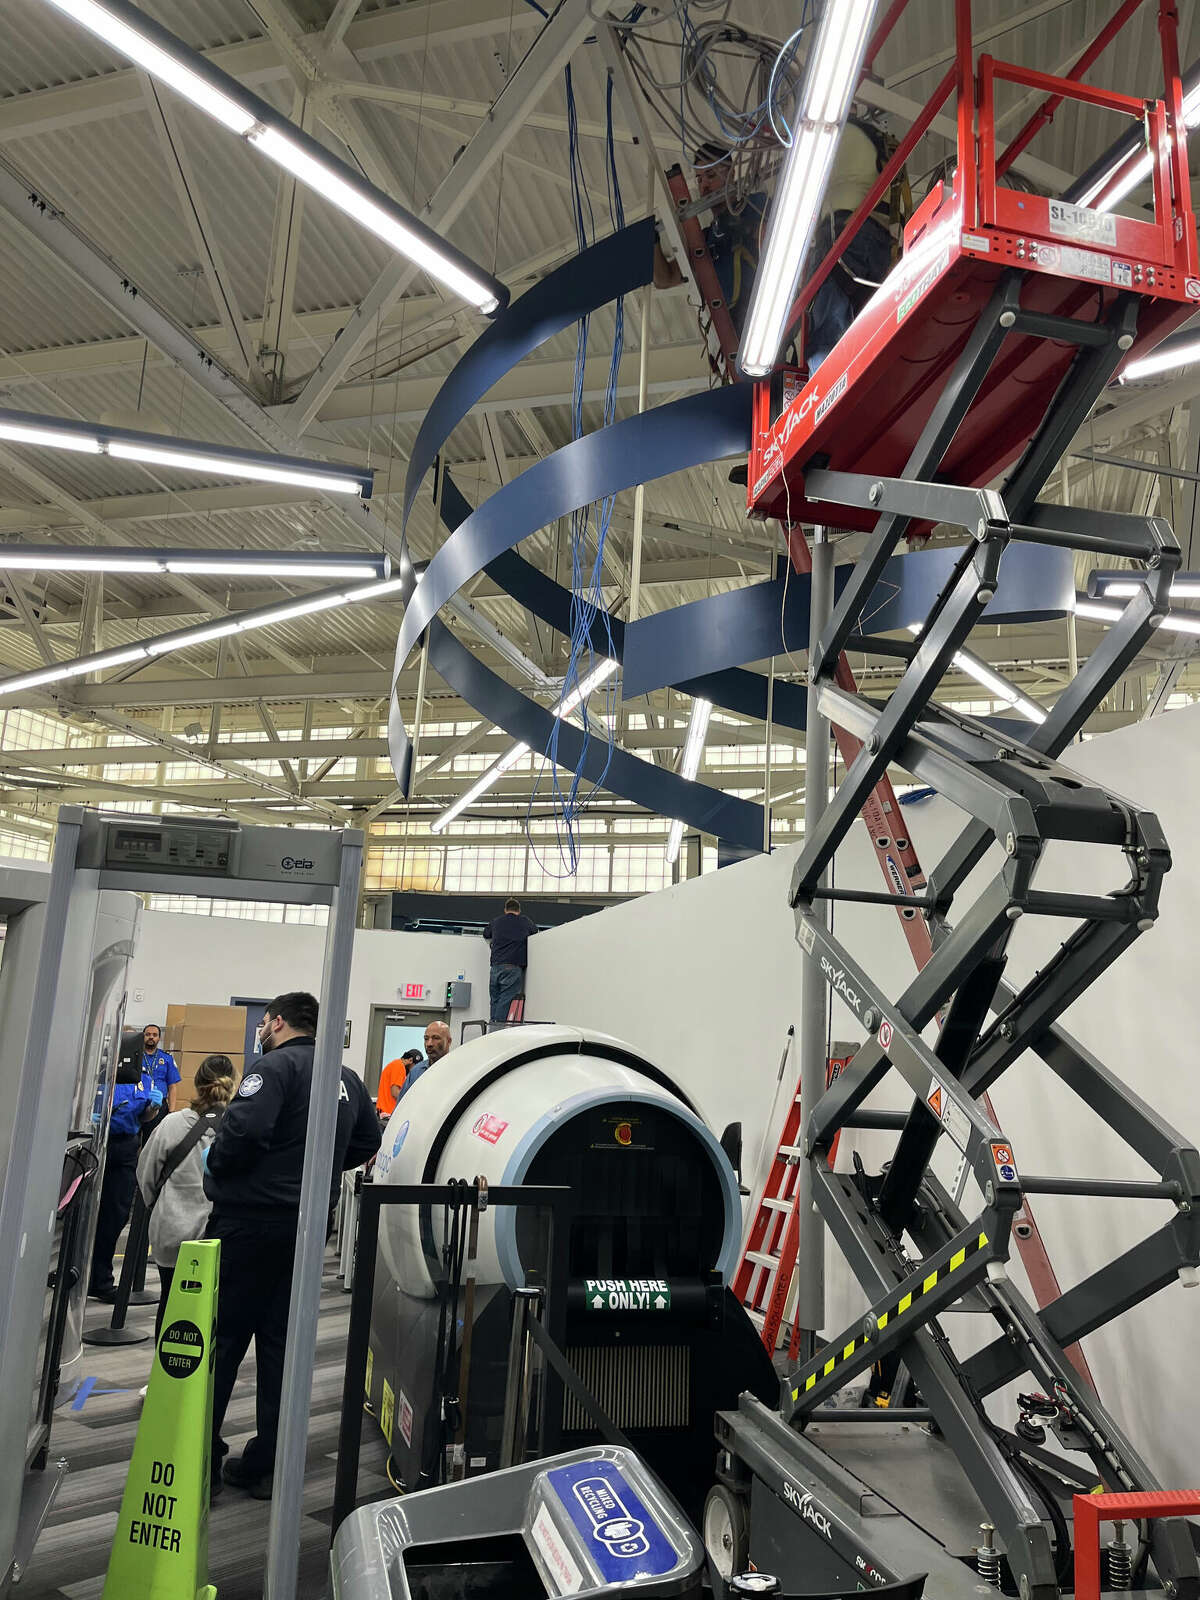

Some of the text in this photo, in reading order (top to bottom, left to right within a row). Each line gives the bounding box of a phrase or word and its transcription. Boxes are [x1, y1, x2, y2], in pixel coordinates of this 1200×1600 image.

[763, 384, 820, 467] SKYJACK
[406, 984, 424, 998] EXIT
[820, 956, 861, 1013] SKYJACK
[586, 1280, 668, 1292] PUSH HERE
[609, 1291, 650, 1310] ONLY!
[169, 1330, 199, 1342] DO NOT
[168, 1356, 191, 1368] ENTER
[151, 1461, 175, 1487] DO
[142, 1491, 177, 1520] NOT
[580, 1485, 608, 1519] RECYCLING
[595, 1487, 616, 1509] MIXED
[783, 1481, 832, 1540] SKYJACK
[129, 1520, 182, 1553] ENTER
